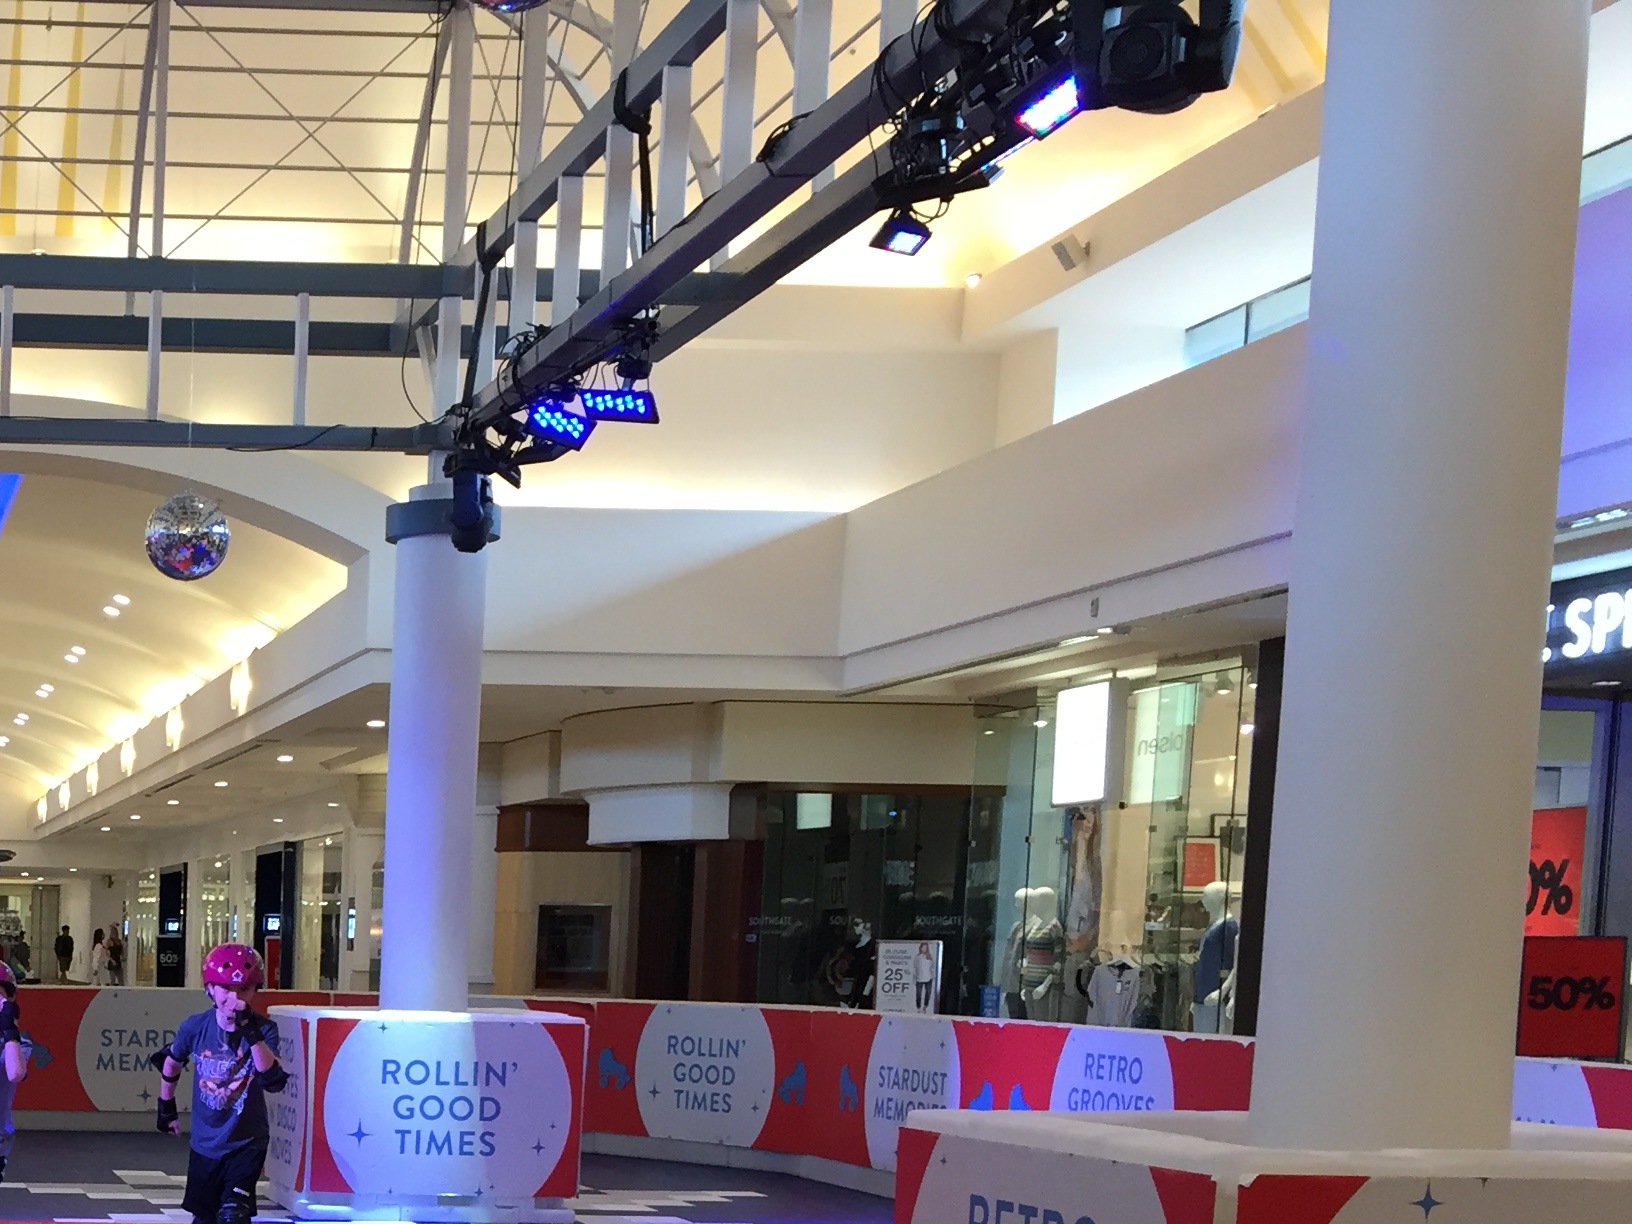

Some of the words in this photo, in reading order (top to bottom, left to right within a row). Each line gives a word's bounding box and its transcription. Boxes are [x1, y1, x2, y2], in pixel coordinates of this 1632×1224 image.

[881, 982, 910, 994] OFF
[1528, 976, 1616, 1011] 50%
[101, 1028, 177, 1048] STARD
[667, 1034, 746, 1059] ROLLIN'
[381, 1059, 519, 1088] ROLLIN'
[673, 1062, 736, 1086] GOOD
[878, 1065, 948, 1095] STARDUST
[1084, 1052, 1143, 1084] RETRO
[392, 1095, 502, 1122] GOOD
[673, 1089, 732, 1113] TIMES
[1068, 1087, 1155, 1111] GROOVES
[394, 1128, 496, 1157] TIMES
